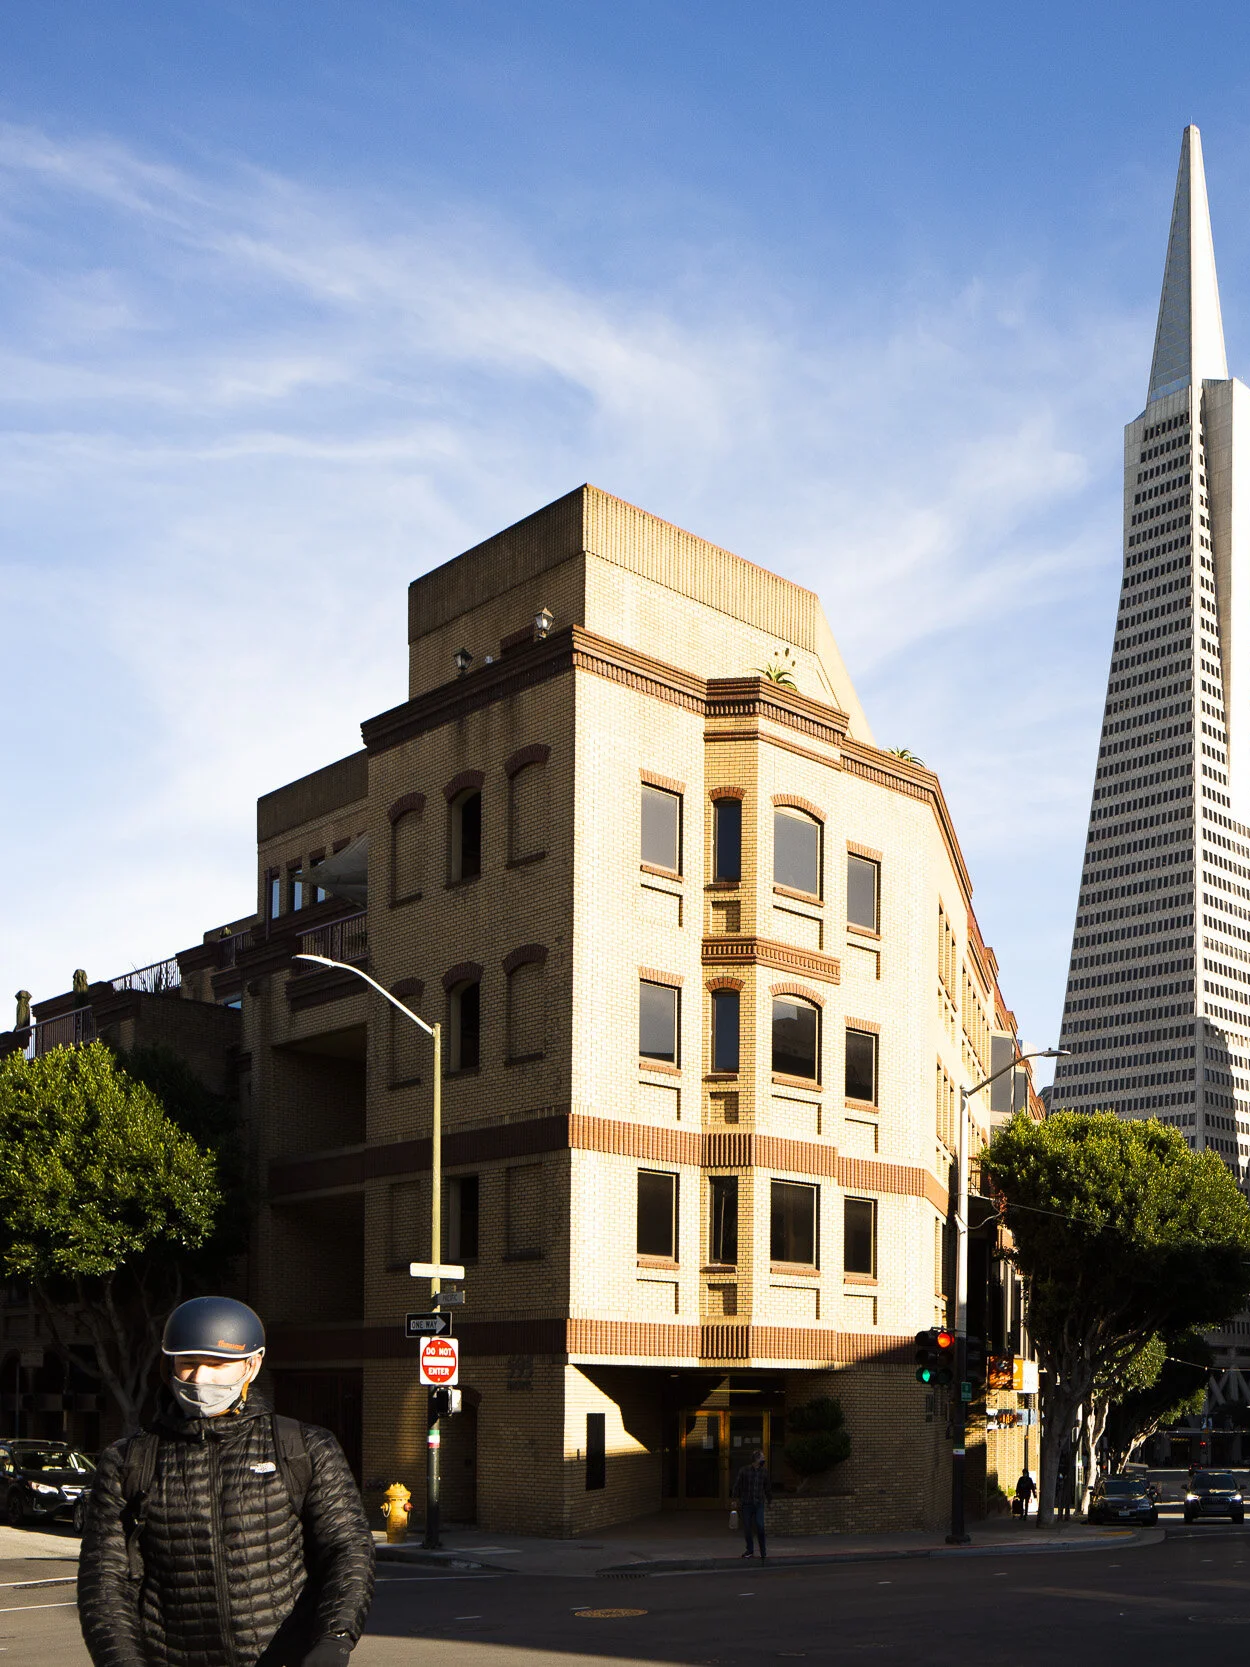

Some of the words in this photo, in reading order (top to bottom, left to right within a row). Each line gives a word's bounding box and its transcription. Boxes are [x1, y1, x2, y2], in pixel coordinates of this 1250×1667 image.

[411, 1321, 424, 1330] ONE
[425, 1321, 437, 1330] WAY
[426, 1348, 436, 1356] DO
[438, 1348, 453, 1356] NOT
[428, 1368, 450, 1376] ENTER
